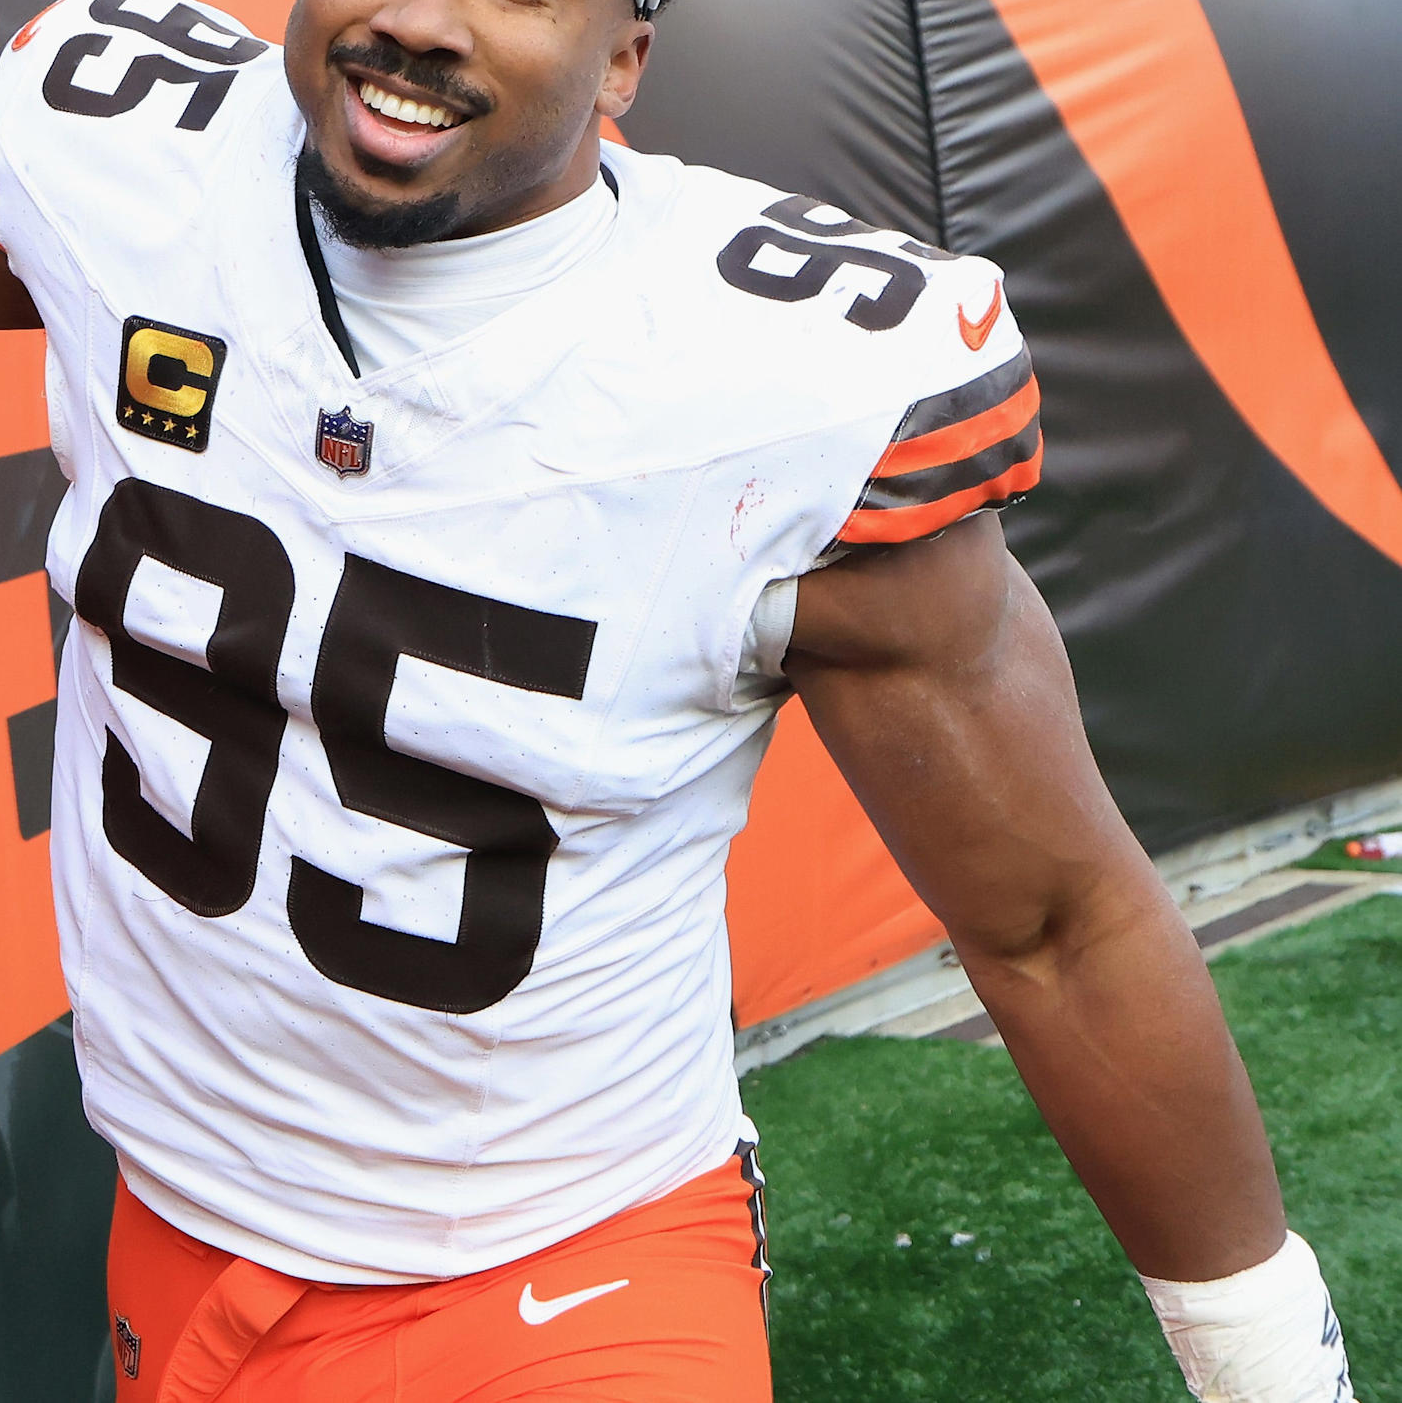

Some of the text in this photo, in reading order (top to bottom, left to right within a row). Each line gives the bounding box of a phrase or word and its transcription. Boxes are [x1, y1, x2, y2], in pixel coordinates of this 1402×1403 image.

[125, 328, 214, 417] C
[323, 436, 364, 470] NFL
[76, 477, 597, 1014] 95
